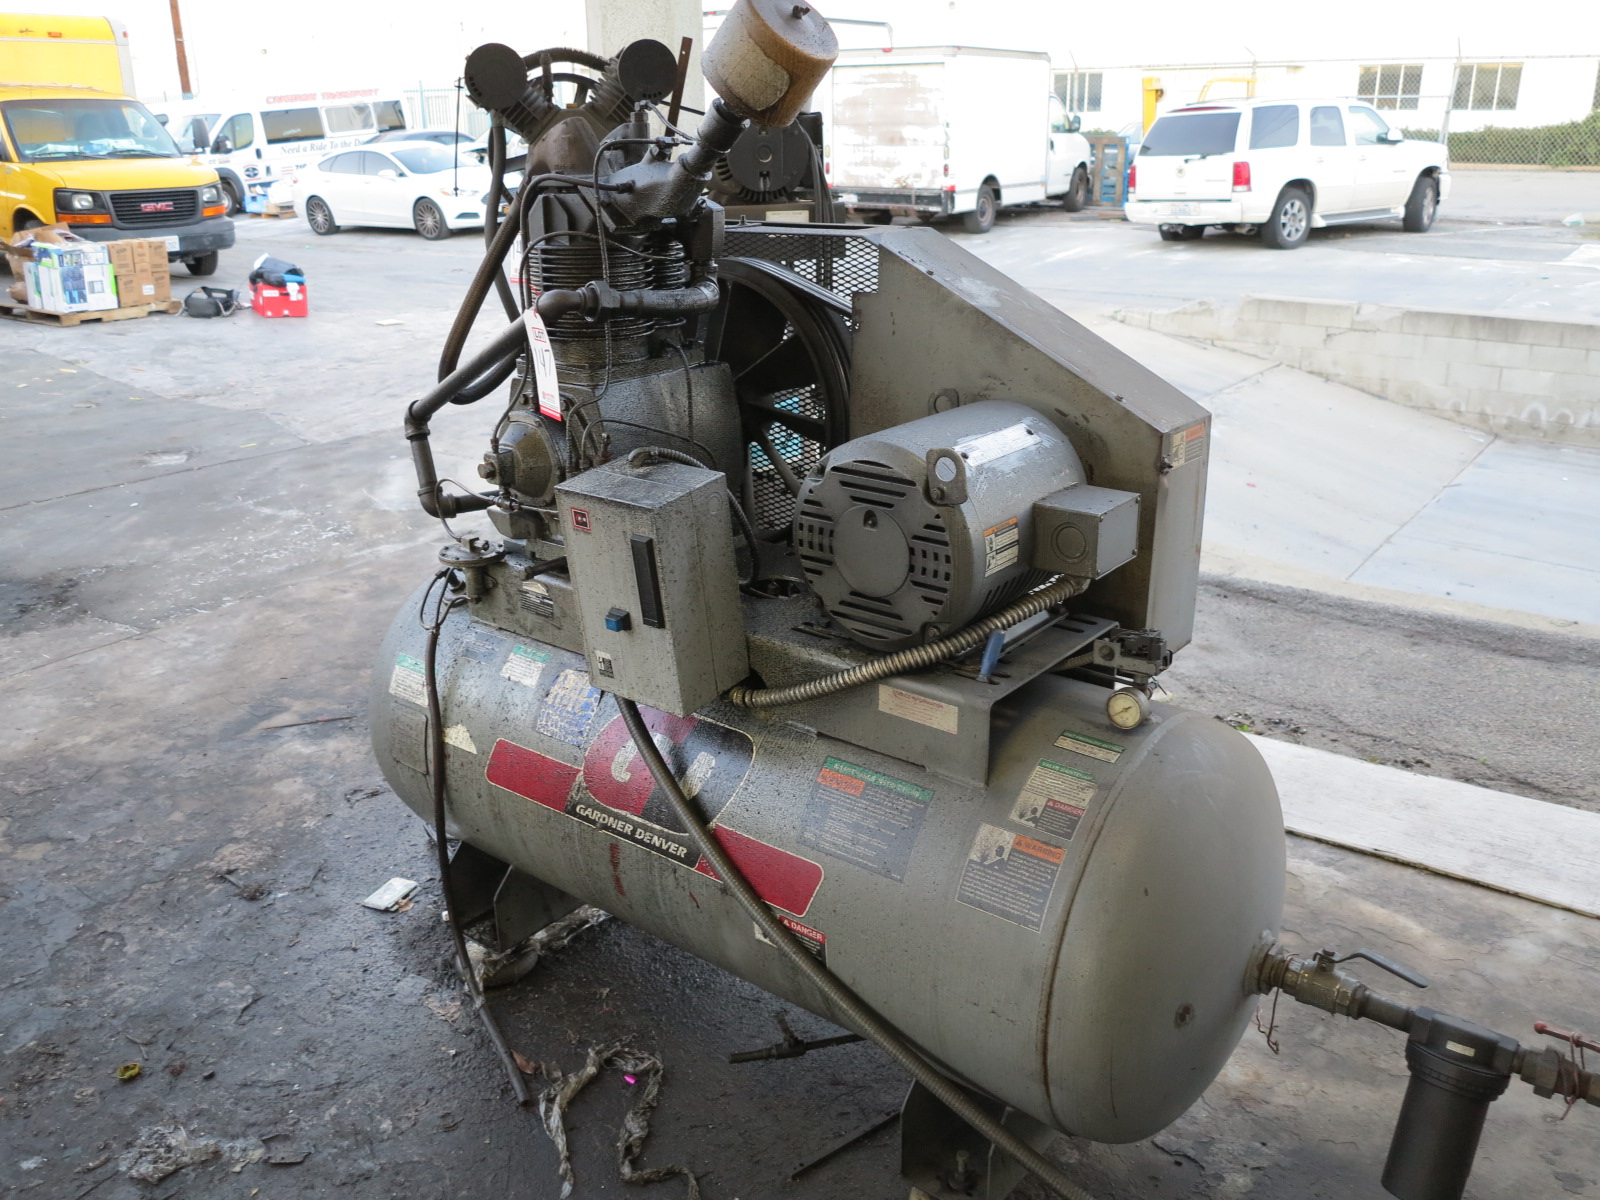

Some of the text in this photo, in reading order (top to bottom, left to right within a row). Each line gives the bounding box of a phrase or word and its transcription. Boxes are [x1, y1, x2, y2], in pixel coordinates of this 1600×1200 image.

[281, 145, 300, 154] Need
[310, 142, 327, 151] Ride
[330, 141, 339, 149] To
[340, 139, 352, 148] the
[141, 202, 174, 212] GMC
[534, 330, 545, 340] LOT
[1054, 802, 1084, 816] DANGER
[576, 804, 687, 858] GARDNER DENVER
[1024, 843, 1061, 860] WARNING
[791, 922, 823, 942] DANGER
